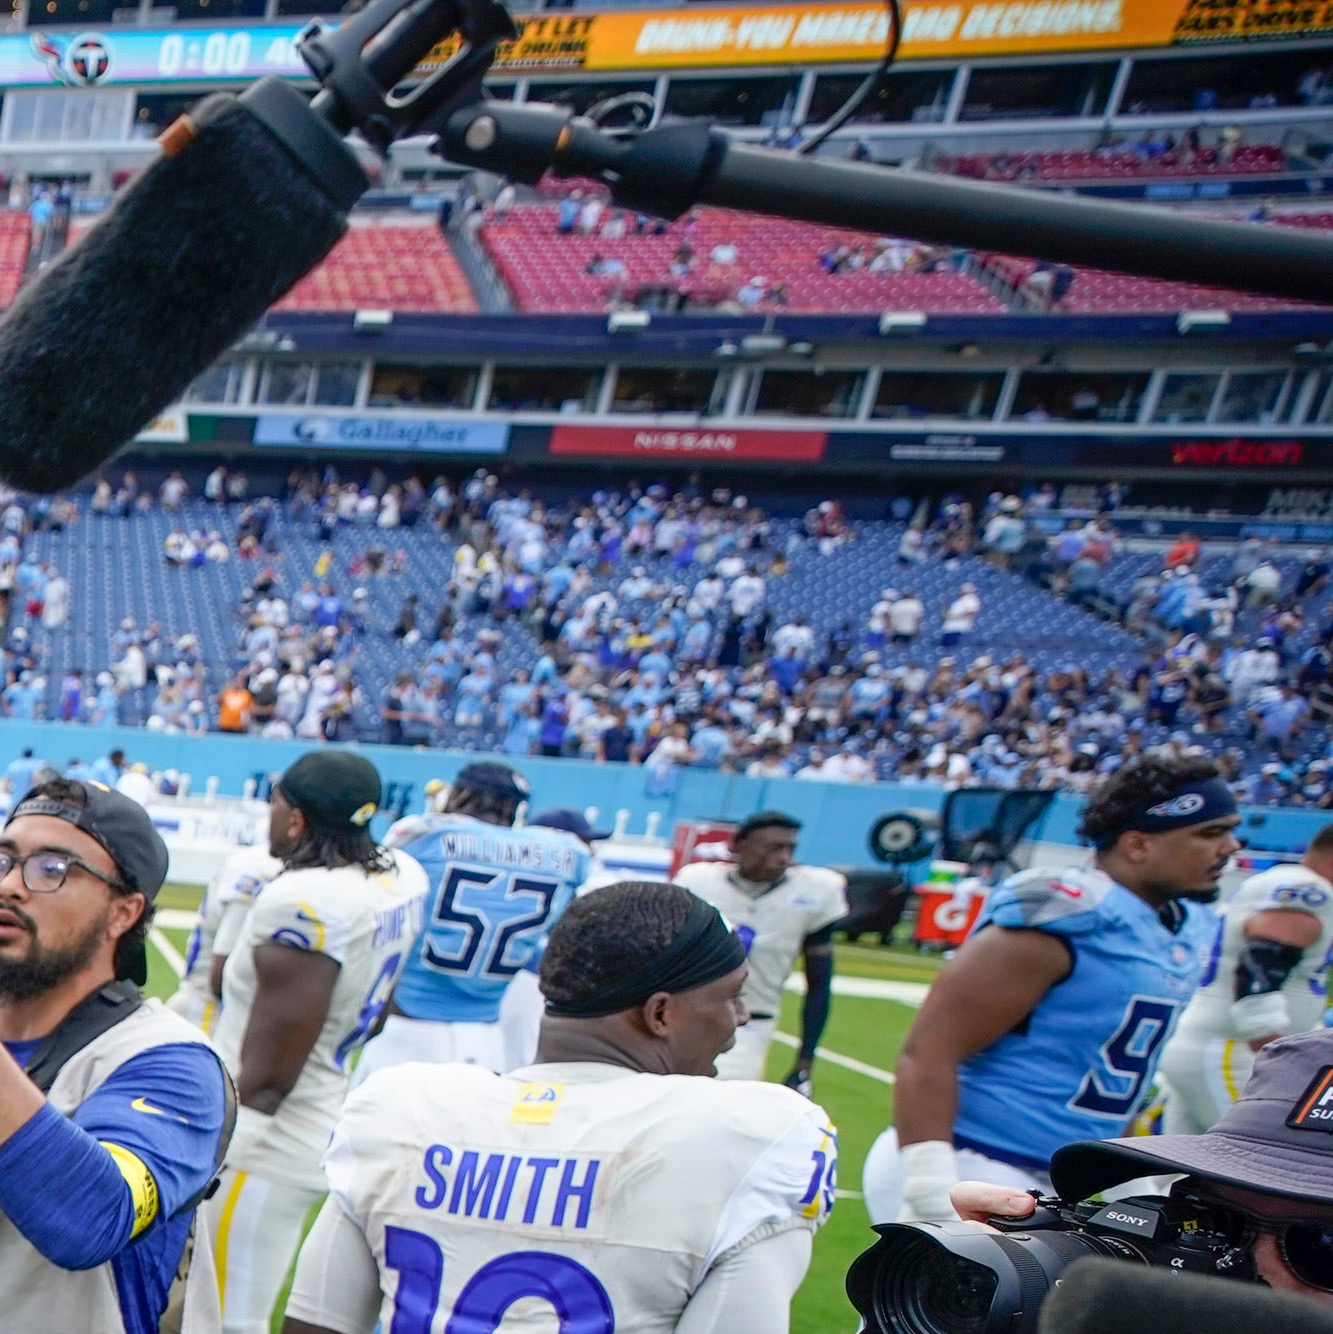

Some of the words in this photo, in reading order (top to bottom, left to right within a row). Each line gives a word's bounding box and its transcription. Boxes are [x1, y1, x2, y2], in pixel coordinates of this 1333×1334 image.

[157, 34, 249, 74] 0:00
[338, 417, 470, 448] Gallagher
[633, 431, 737, 452] NISSAN
[1172, 438, 1303, 465] verizon
[440, 832, 545, 869] WILLIAMS
[550, 848, 575, 874] SR
[421, 860, 566, 980] 52
[414, 1143, 601, 1229] SMITH
[1106, 1210, 1149, 1228] SONY
